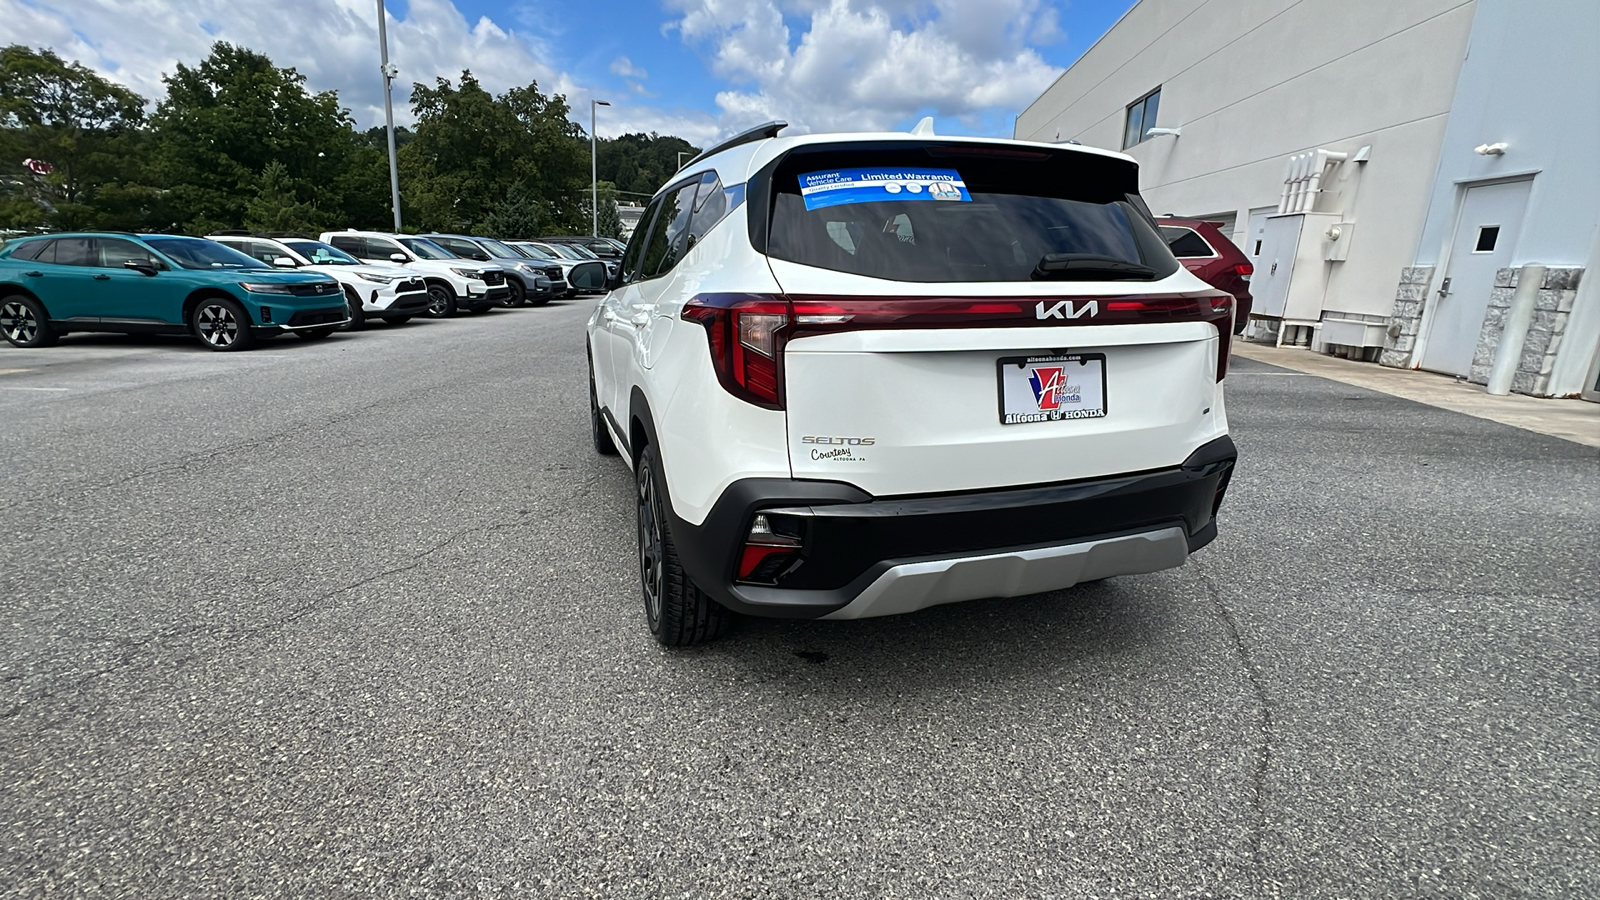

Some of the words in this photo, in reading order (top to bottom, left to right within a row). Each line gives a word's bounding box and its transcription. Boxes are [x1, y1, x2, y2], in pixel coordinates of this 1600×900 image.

[806, 172, 840, 181] Assurant
[861, 172, 902, 181] Limited
[904, 172, 954, 182] Warranty
[807, 178, 834, 187] Vehicle
[1035, 300, 1099, 320] KIA
[1026, 355, 1082, 363] altoonahonda.com
[1055, 393, 1080, 403] Honda
[1005, 411, 1048, 424] Altoona
[1064, 408, 1106, 419] HONDA
[802, 435, 876, 446] SELTOS
[810, 447, 852, 461] Courtesy
